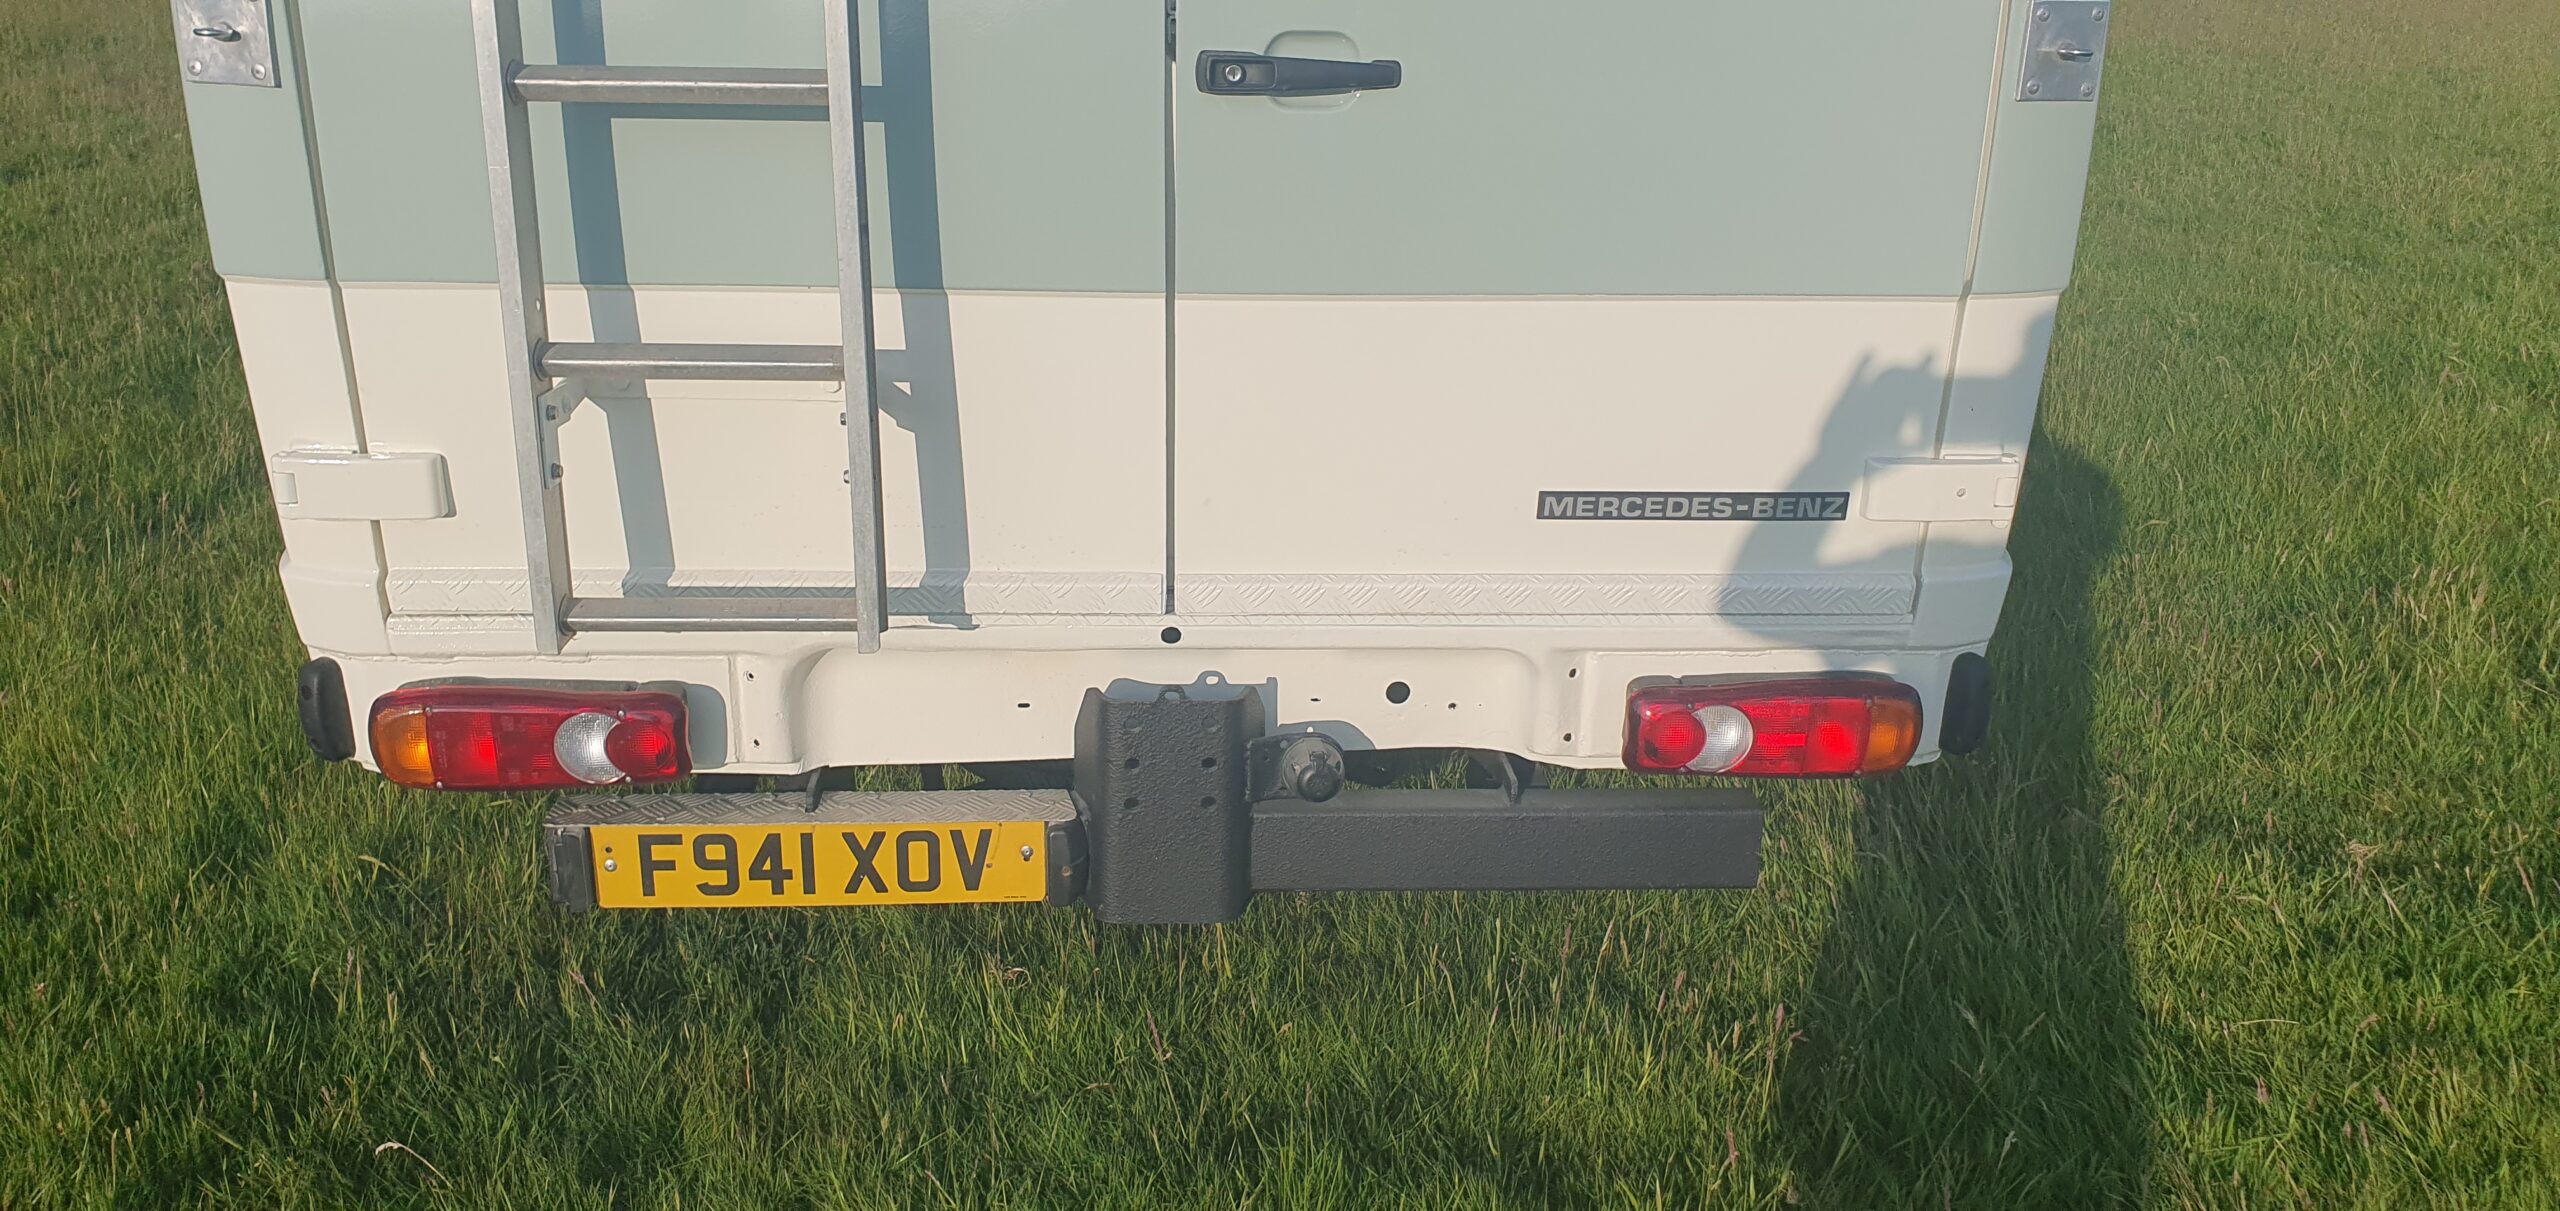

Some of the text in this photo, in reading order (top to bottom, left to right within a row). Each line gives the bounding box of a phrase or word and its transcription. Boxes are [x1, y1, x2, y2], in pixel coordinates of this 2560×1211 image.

[1543, 496, 1846, 518] MERCEDES-BENZ
[638, 829, 993, 896] F941 XOV
